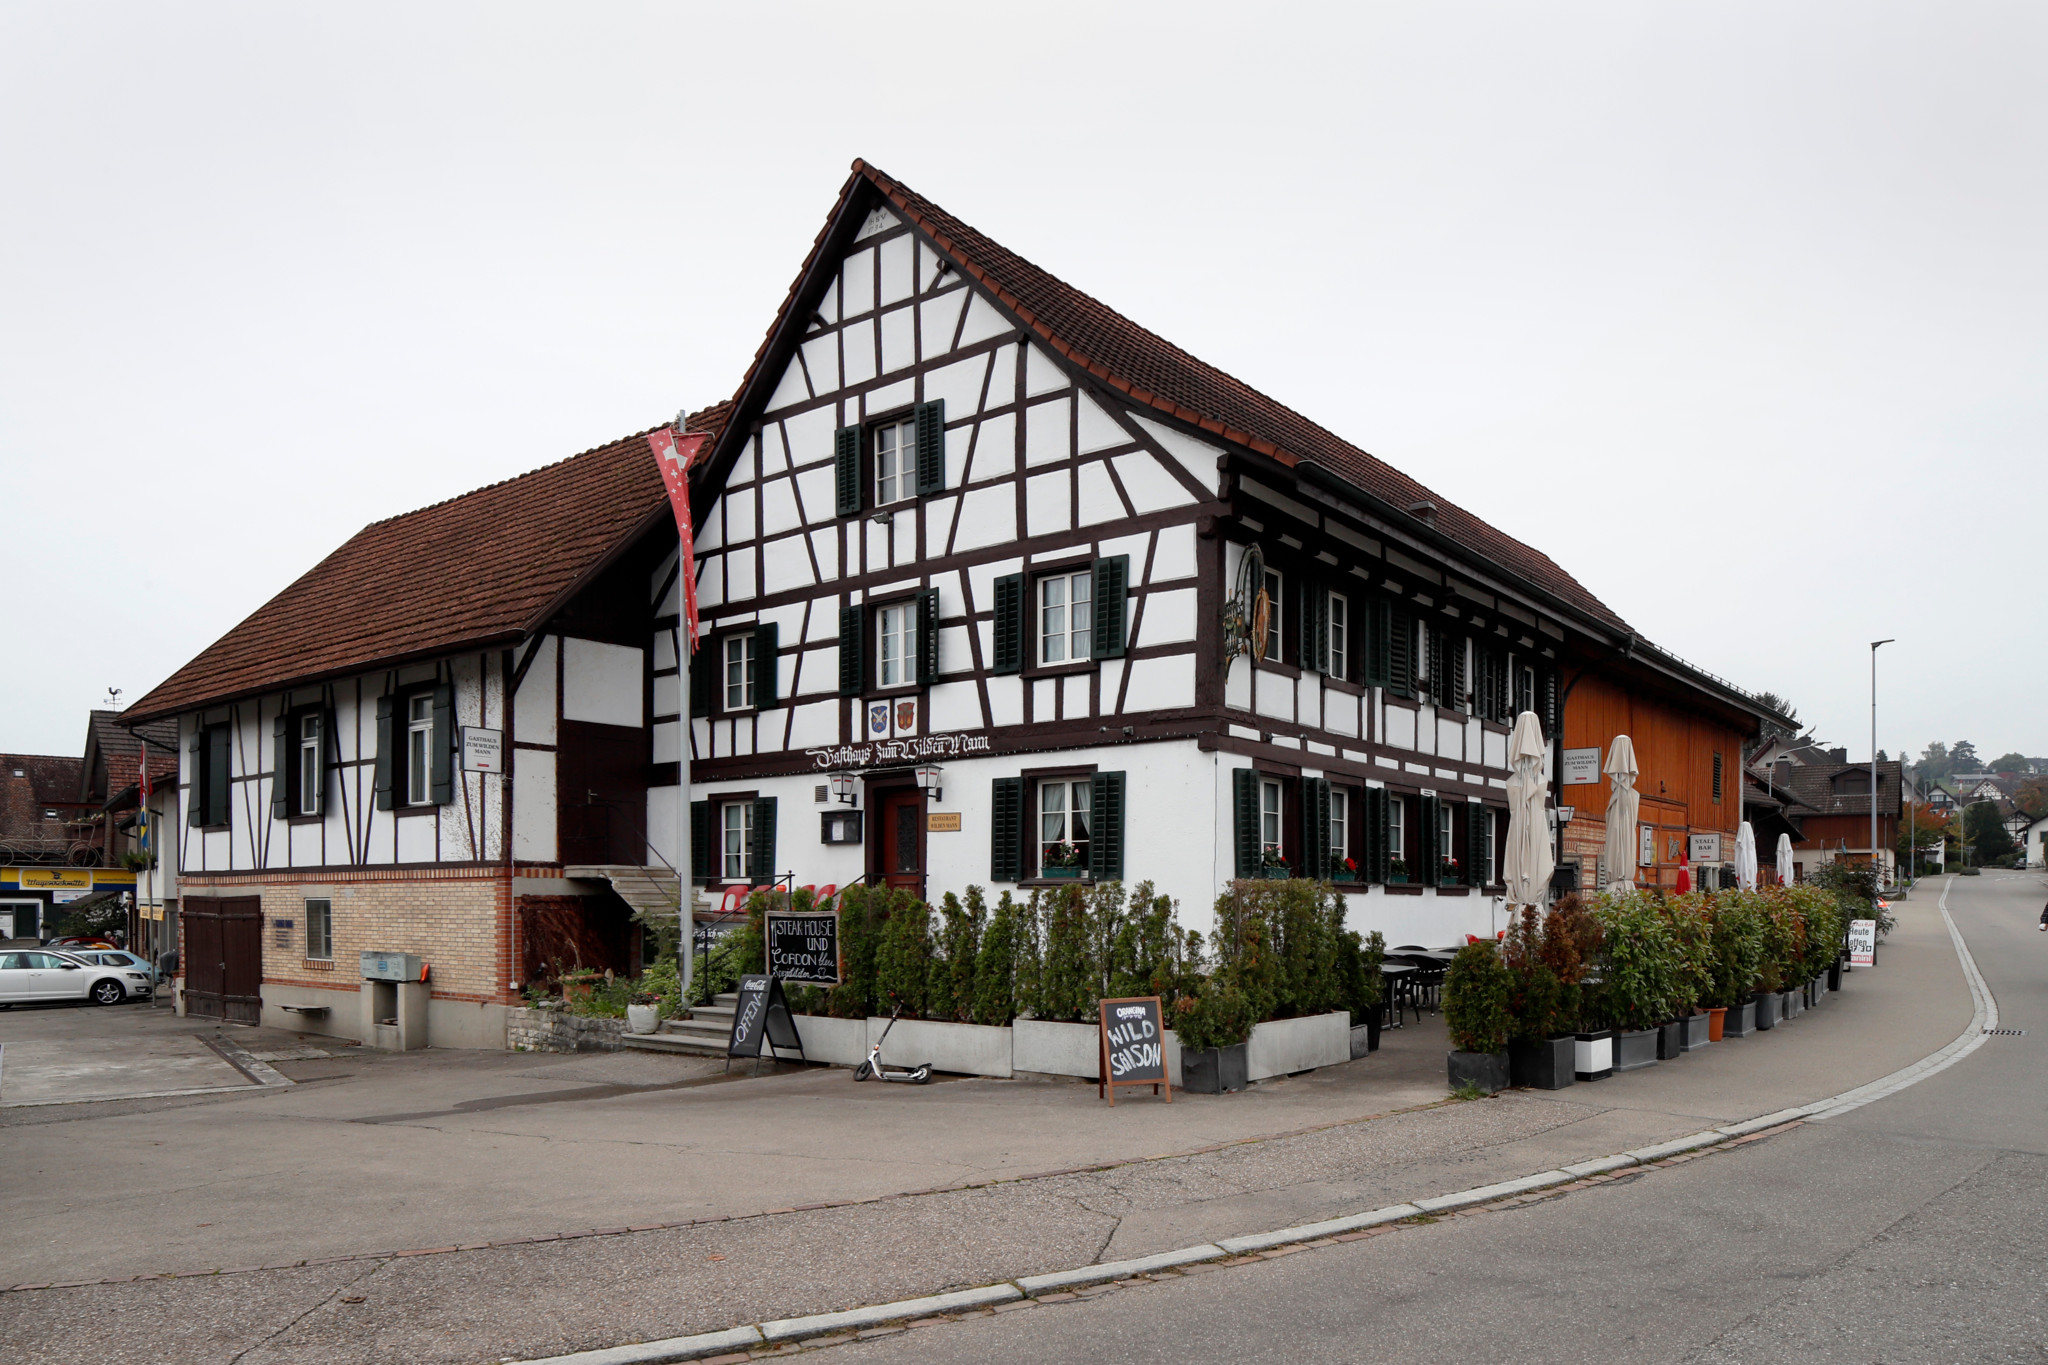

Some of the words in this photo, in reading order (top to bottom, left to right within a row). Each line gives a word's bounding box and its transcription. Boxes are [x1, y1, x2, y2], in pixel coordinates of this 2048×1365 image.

[776, 920, 803, 936] STEAK
[804, 920, 834, 937] HOUSE
[807, 938, 829, 951] UND
[735, 992, 762, 1043] OFFEN
[1107, 1019, 1156, 1048] WILD
[1110, 1042, 1161, 1076] SAISON
